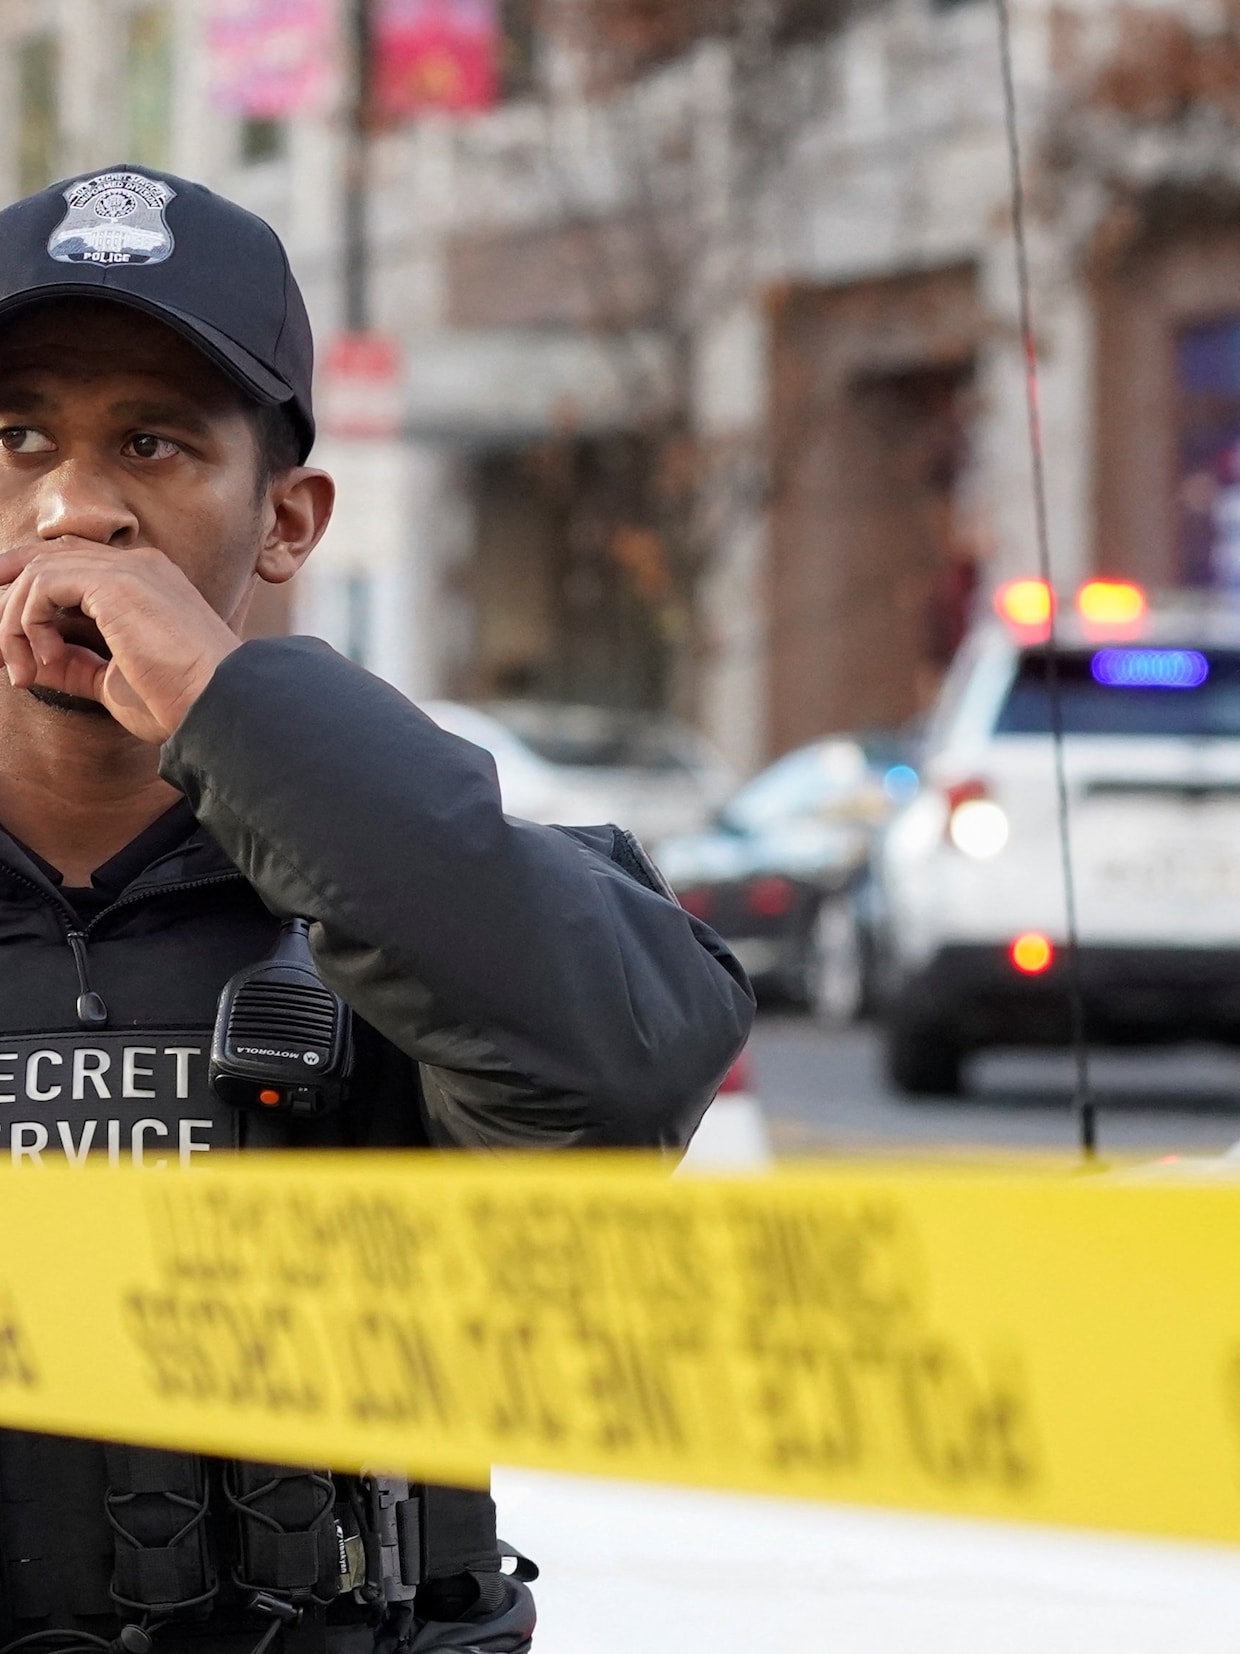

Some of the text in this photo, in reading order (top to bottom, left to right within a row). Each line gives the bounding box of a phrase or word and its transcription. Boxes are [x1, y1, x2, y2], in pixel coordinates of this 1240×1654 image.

[76, 181, 124, 207] UNIFORMED
[126, 181, 160, 207] DIVISION
[83, 252, 131, 263] POLICE
[237, 1046, 299, 1059] MOTOROLA
